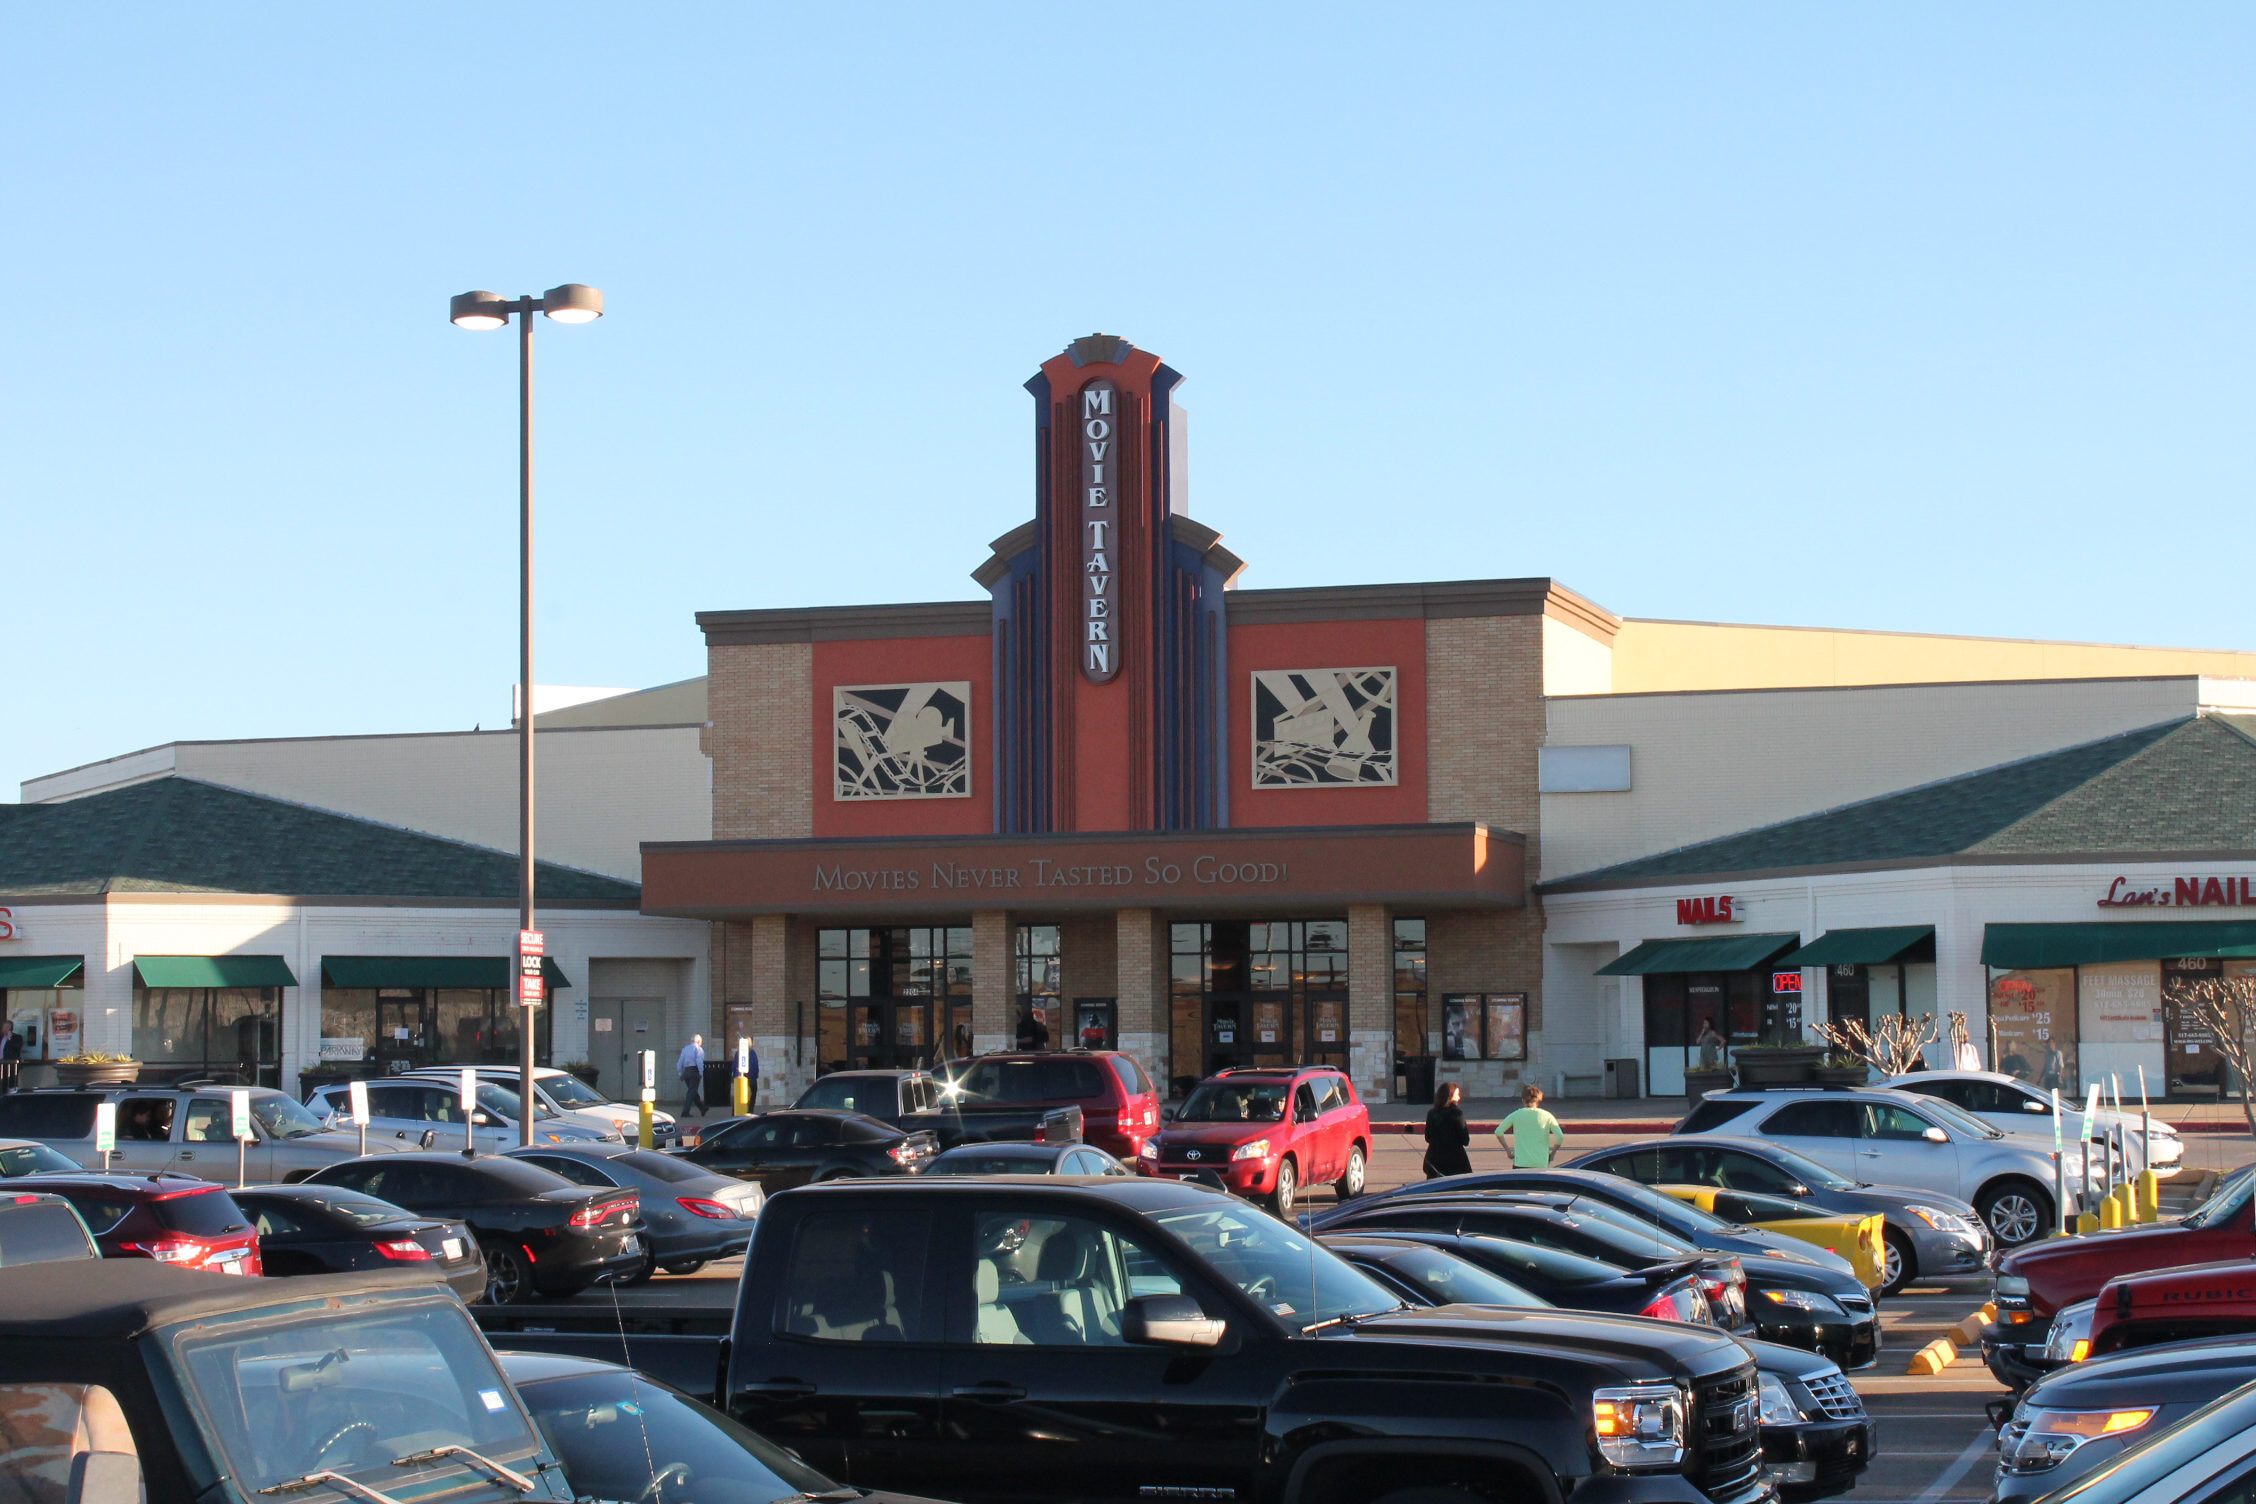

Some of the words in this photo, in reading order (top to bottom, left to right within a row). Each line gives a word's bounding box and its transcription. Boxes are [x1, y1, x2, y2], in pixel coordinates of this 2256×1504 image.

[1083, 389, 1111, 507] MOVIE
[1086, 520, 1110, 673] TAVERN
[812, 864, 920, 891] MOVIES
[930, 861, 1022, 889] NEVER
[1029, 858, 1134, 887] TASTED
[1144, 856, 1182, 885] SO
[1193, 855, 1289, 884] GOOD!
[2097, 876, 2171, 907] Lan's
[1677, 895, 1734, 925] NAILS
[521, 931, 544, 945] SECURE
[522, 955, 542, 969] LOCK
[2178, 957, 2207, 970] 460
[1837, 964, 1855, 977] 460
[523, 978, 541, 991] TAKE
[1775, 974, 1802, 992] OPEN
[1998, 980, 2033, 993] OPEN
[2083, 975, 2105, 986] FEET
[2109, 975, 2156, 986] MASSAGE
[1139, 1485, 1235, 1499] SIERRA
